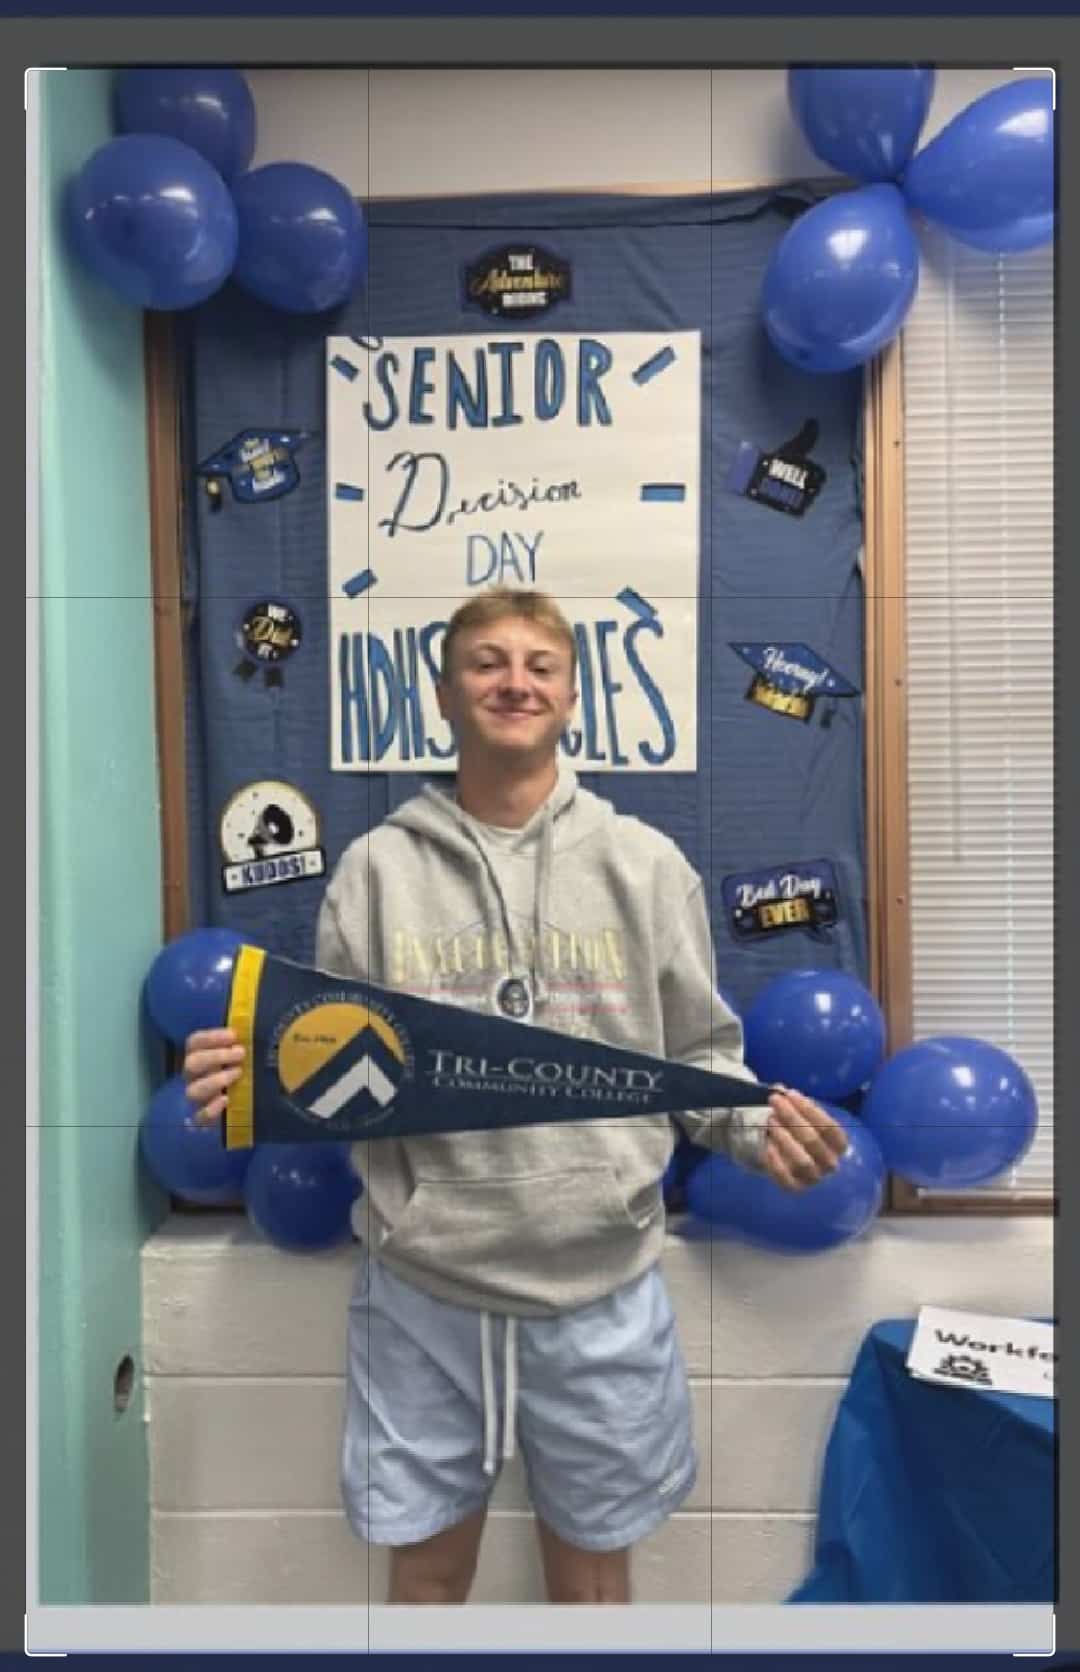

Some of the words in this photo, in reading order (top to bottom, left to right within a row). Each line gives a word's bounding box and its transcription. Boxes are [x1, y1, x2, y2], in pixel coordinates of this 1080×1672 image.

[362, 338, 613, 430] SENIOR
[378, 450, 582, 537] Decision
[768, 458, 808, 489] WELL
[466, 530, 544, 586] DAY
[339, 619, 458, 763] HDHS
[240, 853, 304, 886] KUDOS!
[759, 898, 809, 928] EVER
